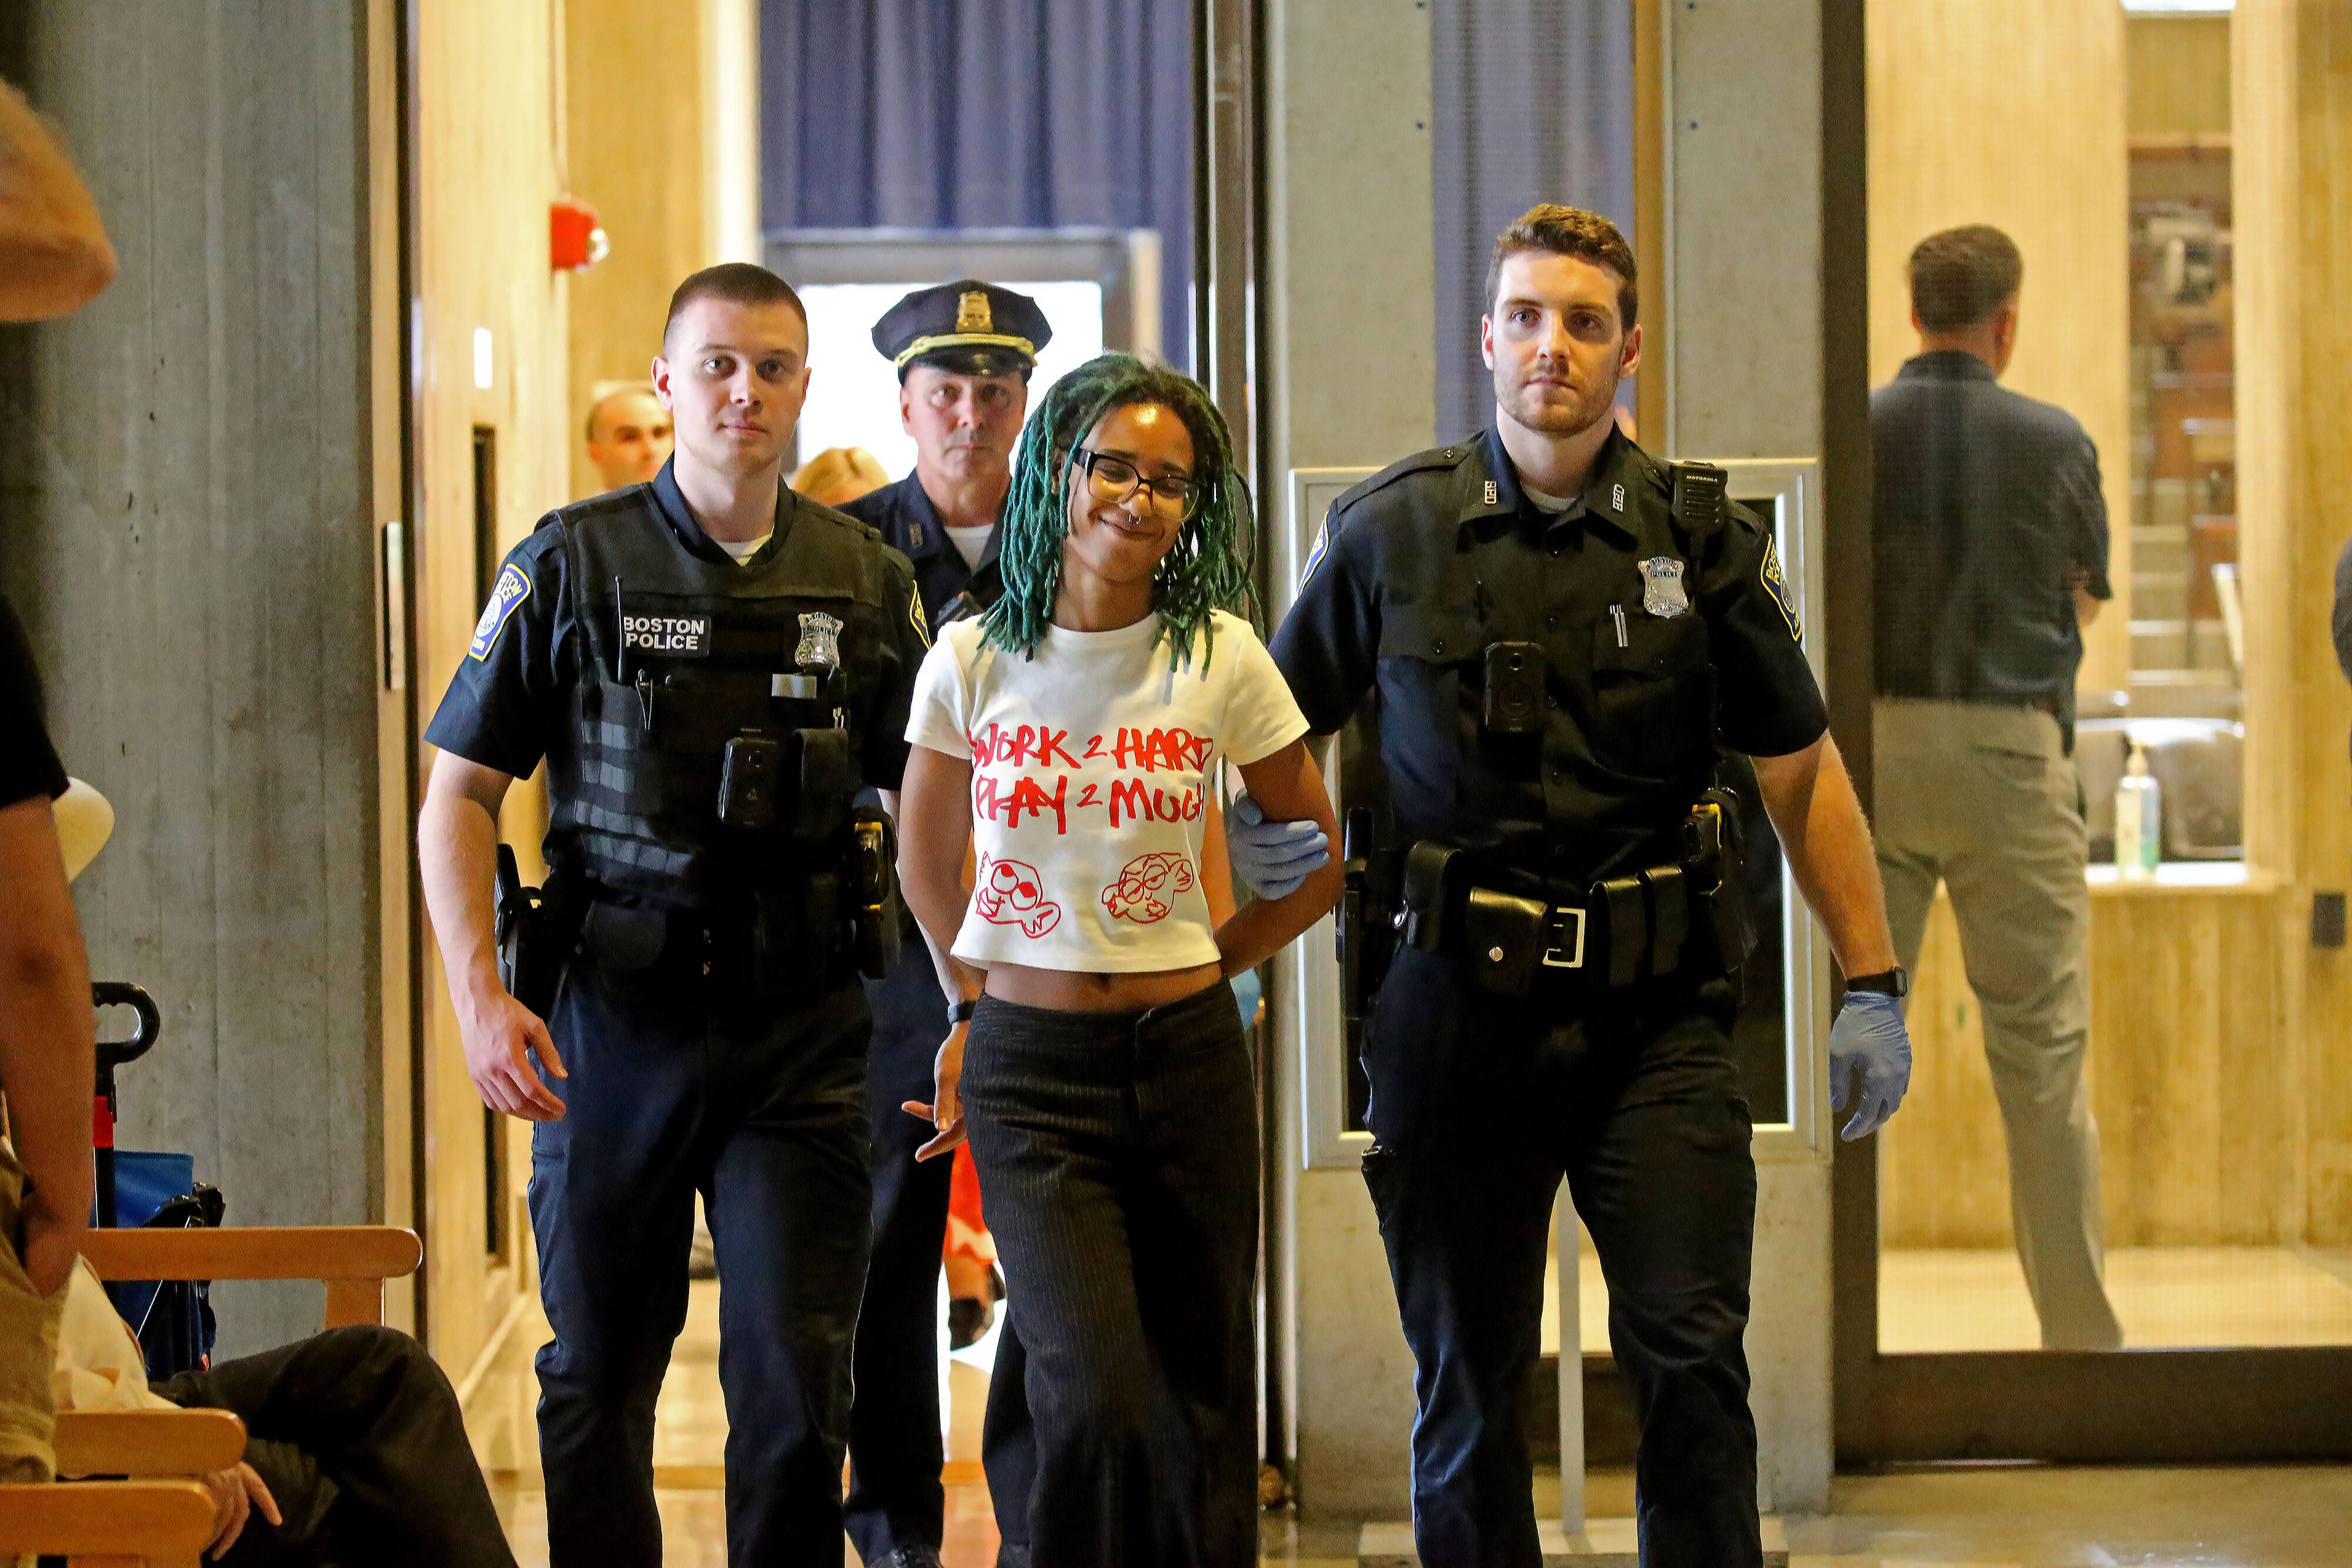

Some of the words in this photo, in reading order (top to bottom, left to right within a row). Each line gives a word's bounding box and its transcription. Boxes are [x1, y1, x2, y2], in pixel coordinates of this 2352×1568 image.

[501, 571, 523, 597] STON
[623, 617, 705, 634] BOSTON
[626, 633, 699, 650] POLICE
[969, 723, 1081, 770] WORK
[1083, 735, 1107, 759] 2
[1111, 728, 1214, 773] HARD
[976, 774, 1068, 835] PLAY
[1077, 784, 1102, 808] 2
